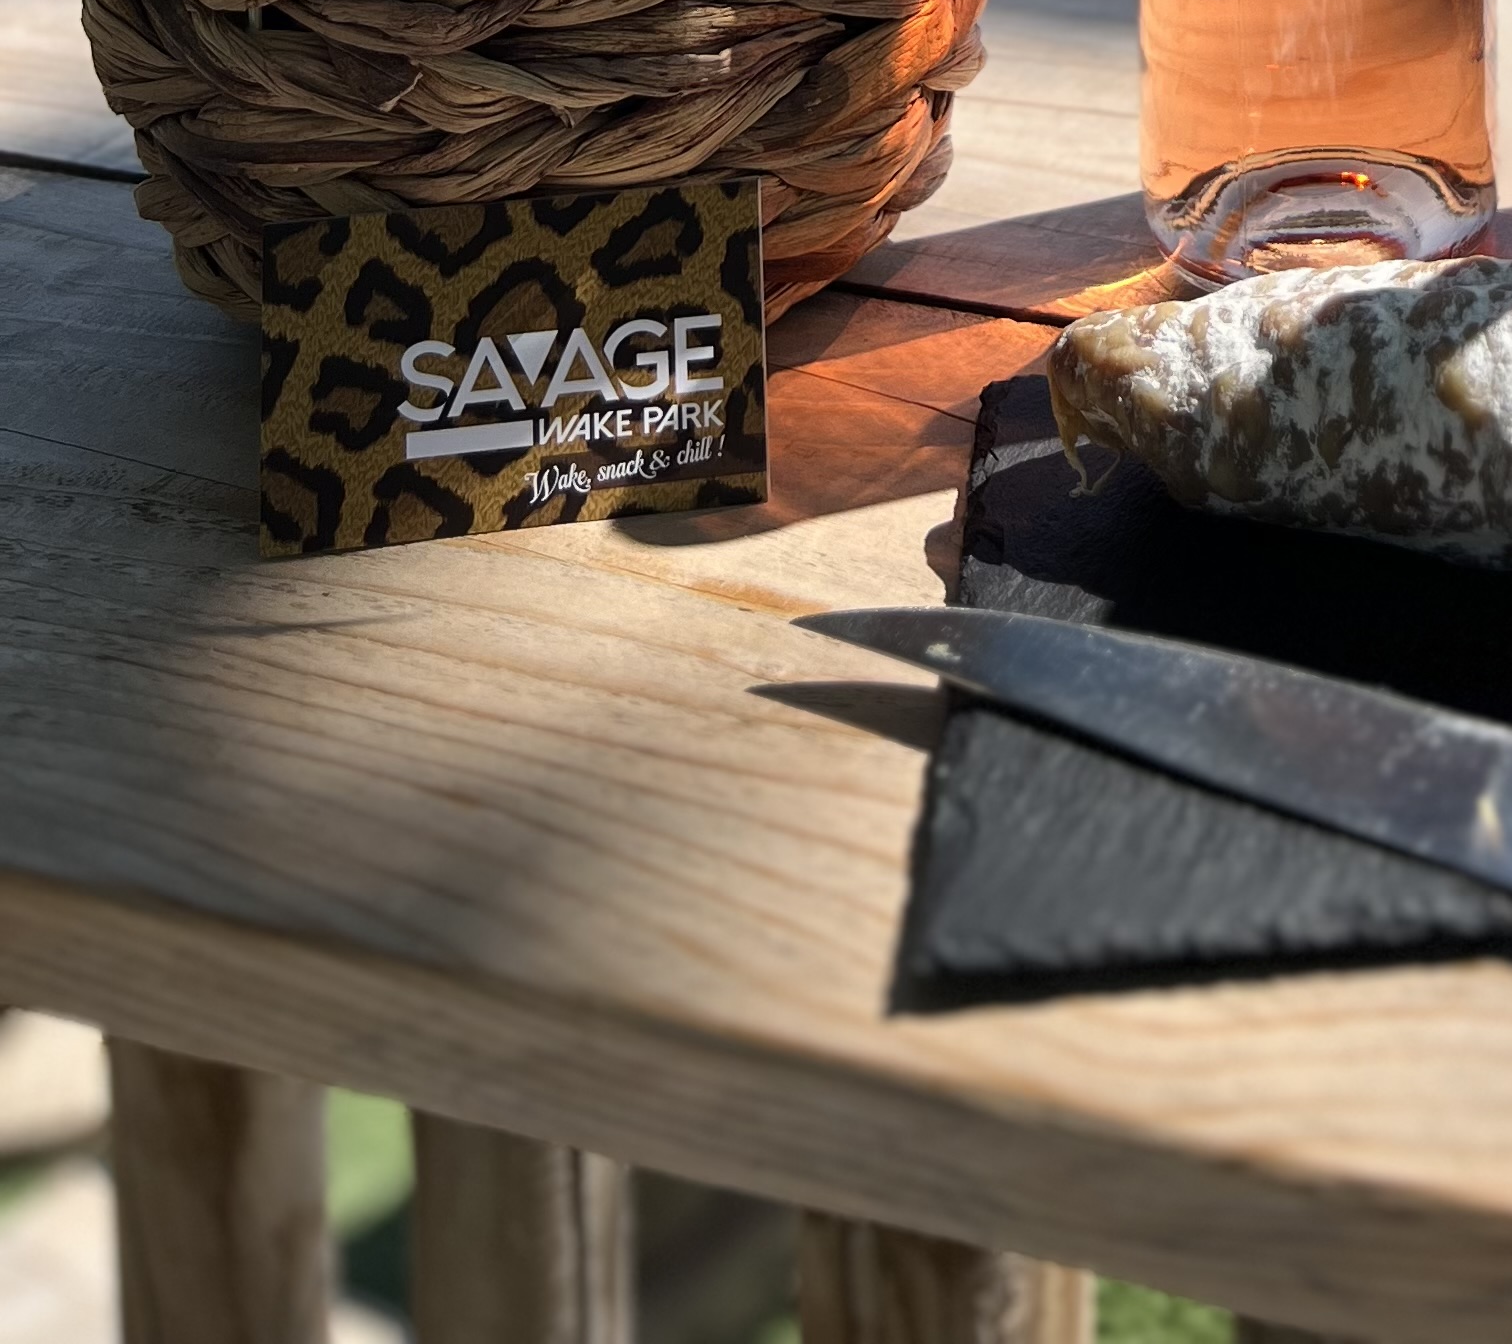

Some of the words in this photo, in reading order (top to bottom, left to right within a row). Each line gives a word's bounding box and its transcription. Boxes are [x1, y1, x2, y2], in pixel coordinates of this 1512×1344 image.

[397, 314, 724, 423] SAVAGE
[538, 409, 633, 446] WAKE
[643, 399, 724, 435] PARK
[597, 449, 657, 482] snack
[649, 449, 670, 471] &
